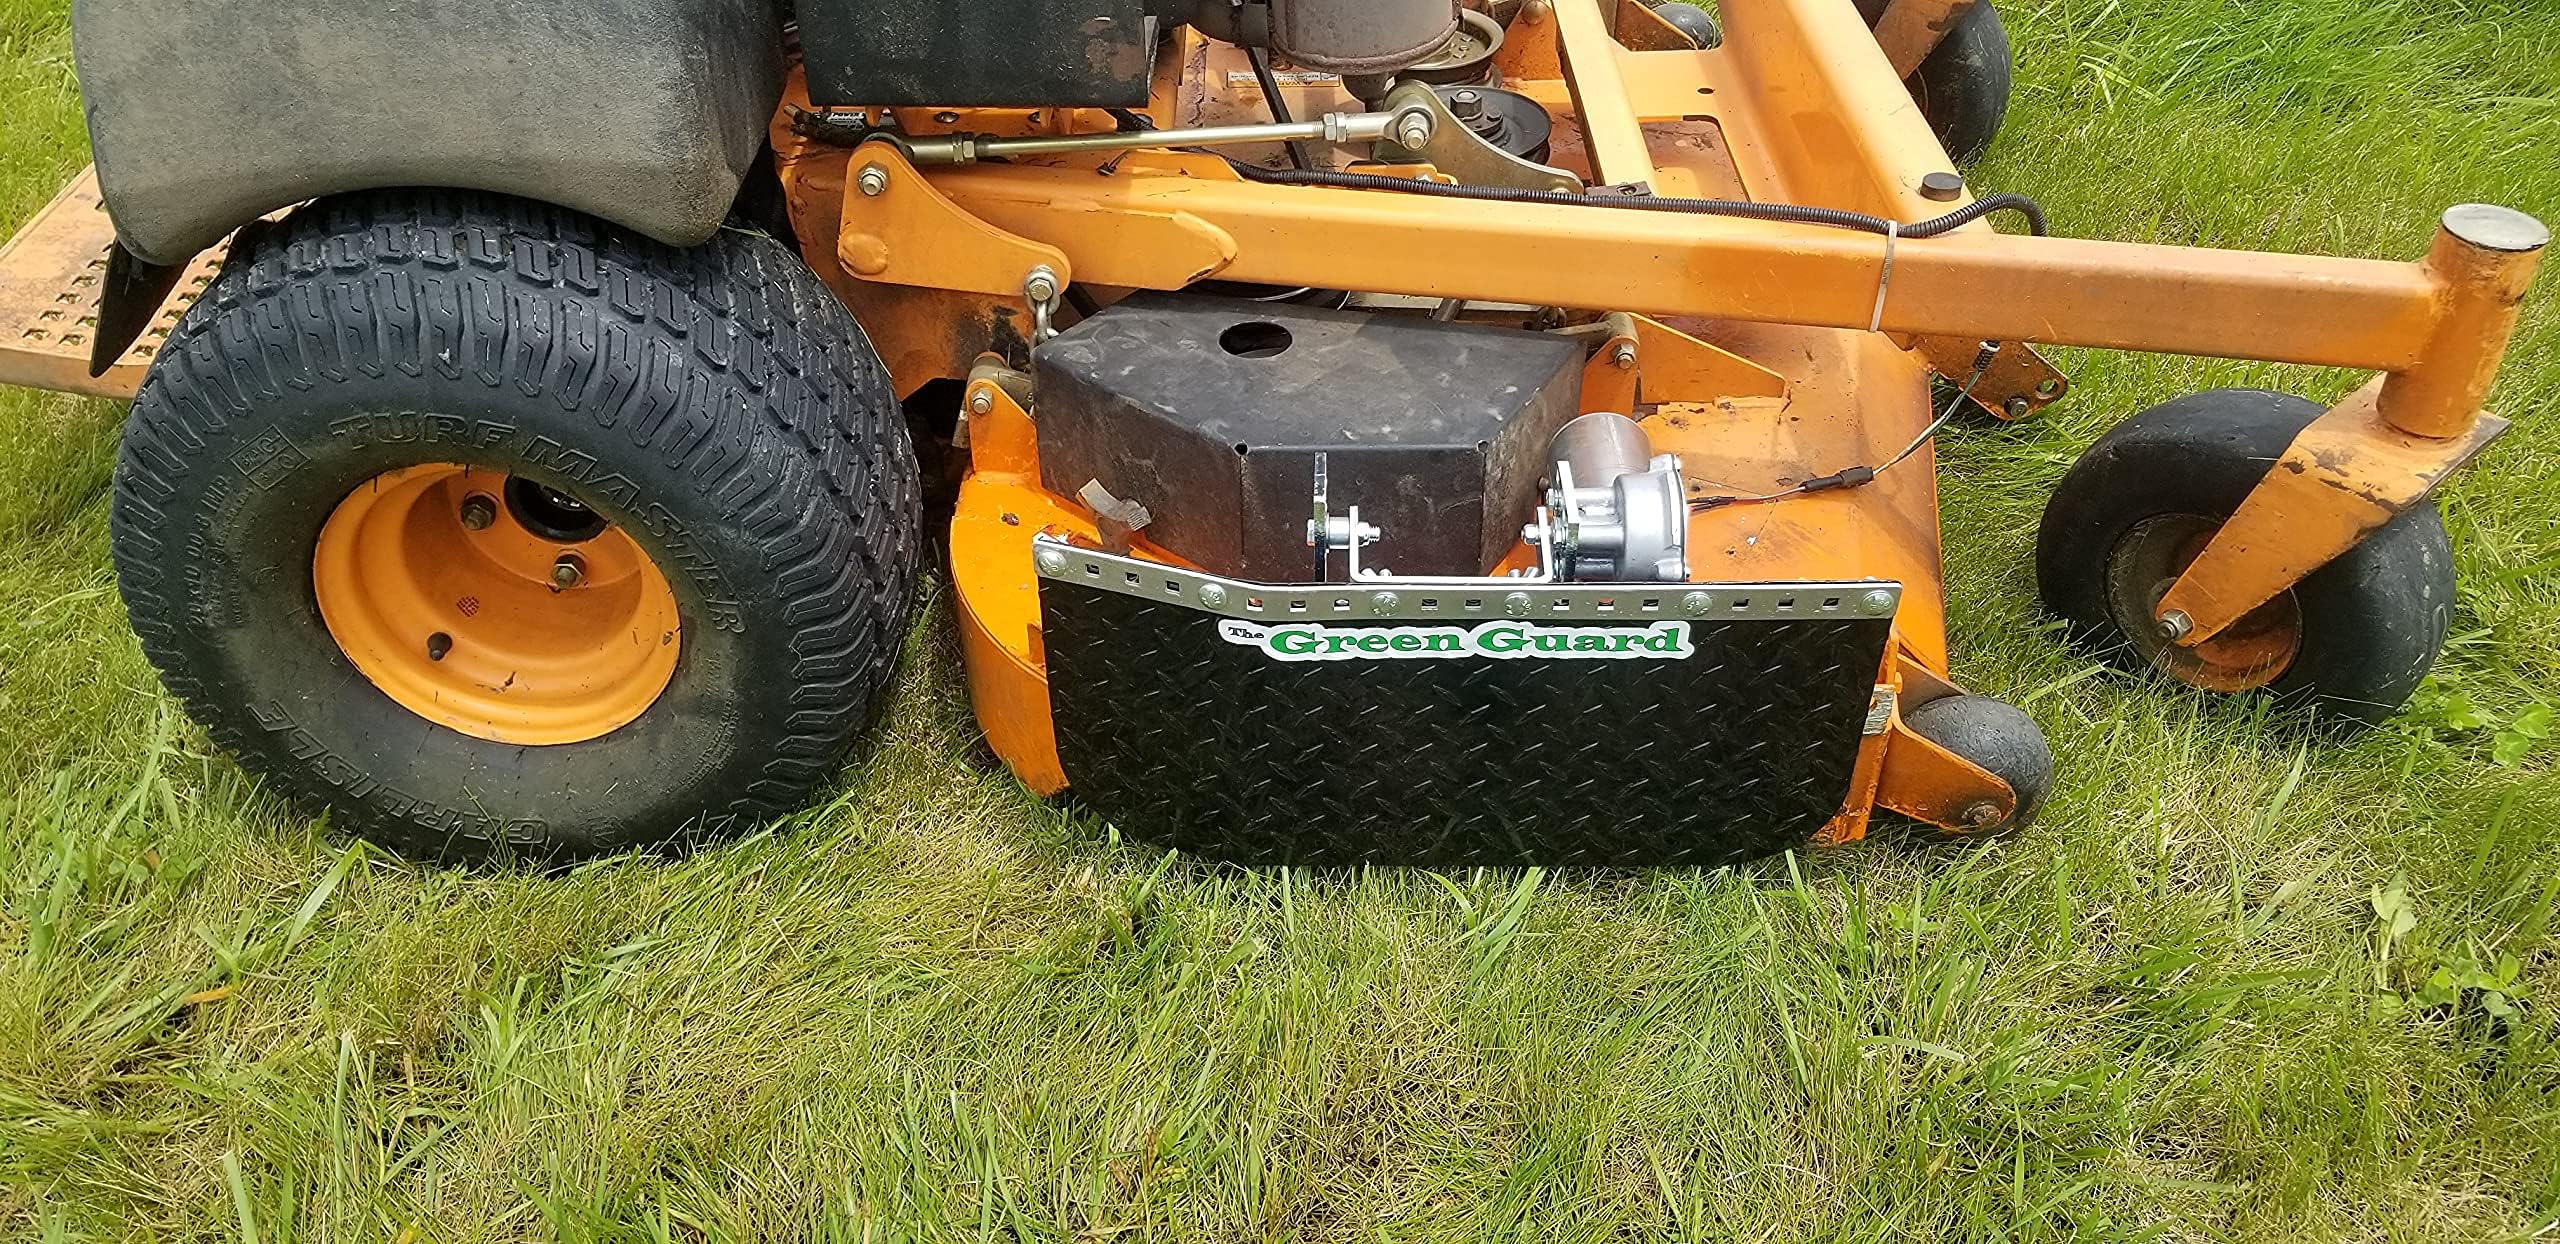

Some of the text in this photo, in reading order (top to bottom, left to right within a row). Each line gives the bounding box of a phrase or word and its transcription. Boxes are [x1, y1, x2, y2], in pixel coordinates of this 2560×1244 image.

[328, 411, 746, 634] TURF MASTER
[1228, 626, 1687, 655] The Green Guard
[245, 698, 550, 845] CARLISLE
